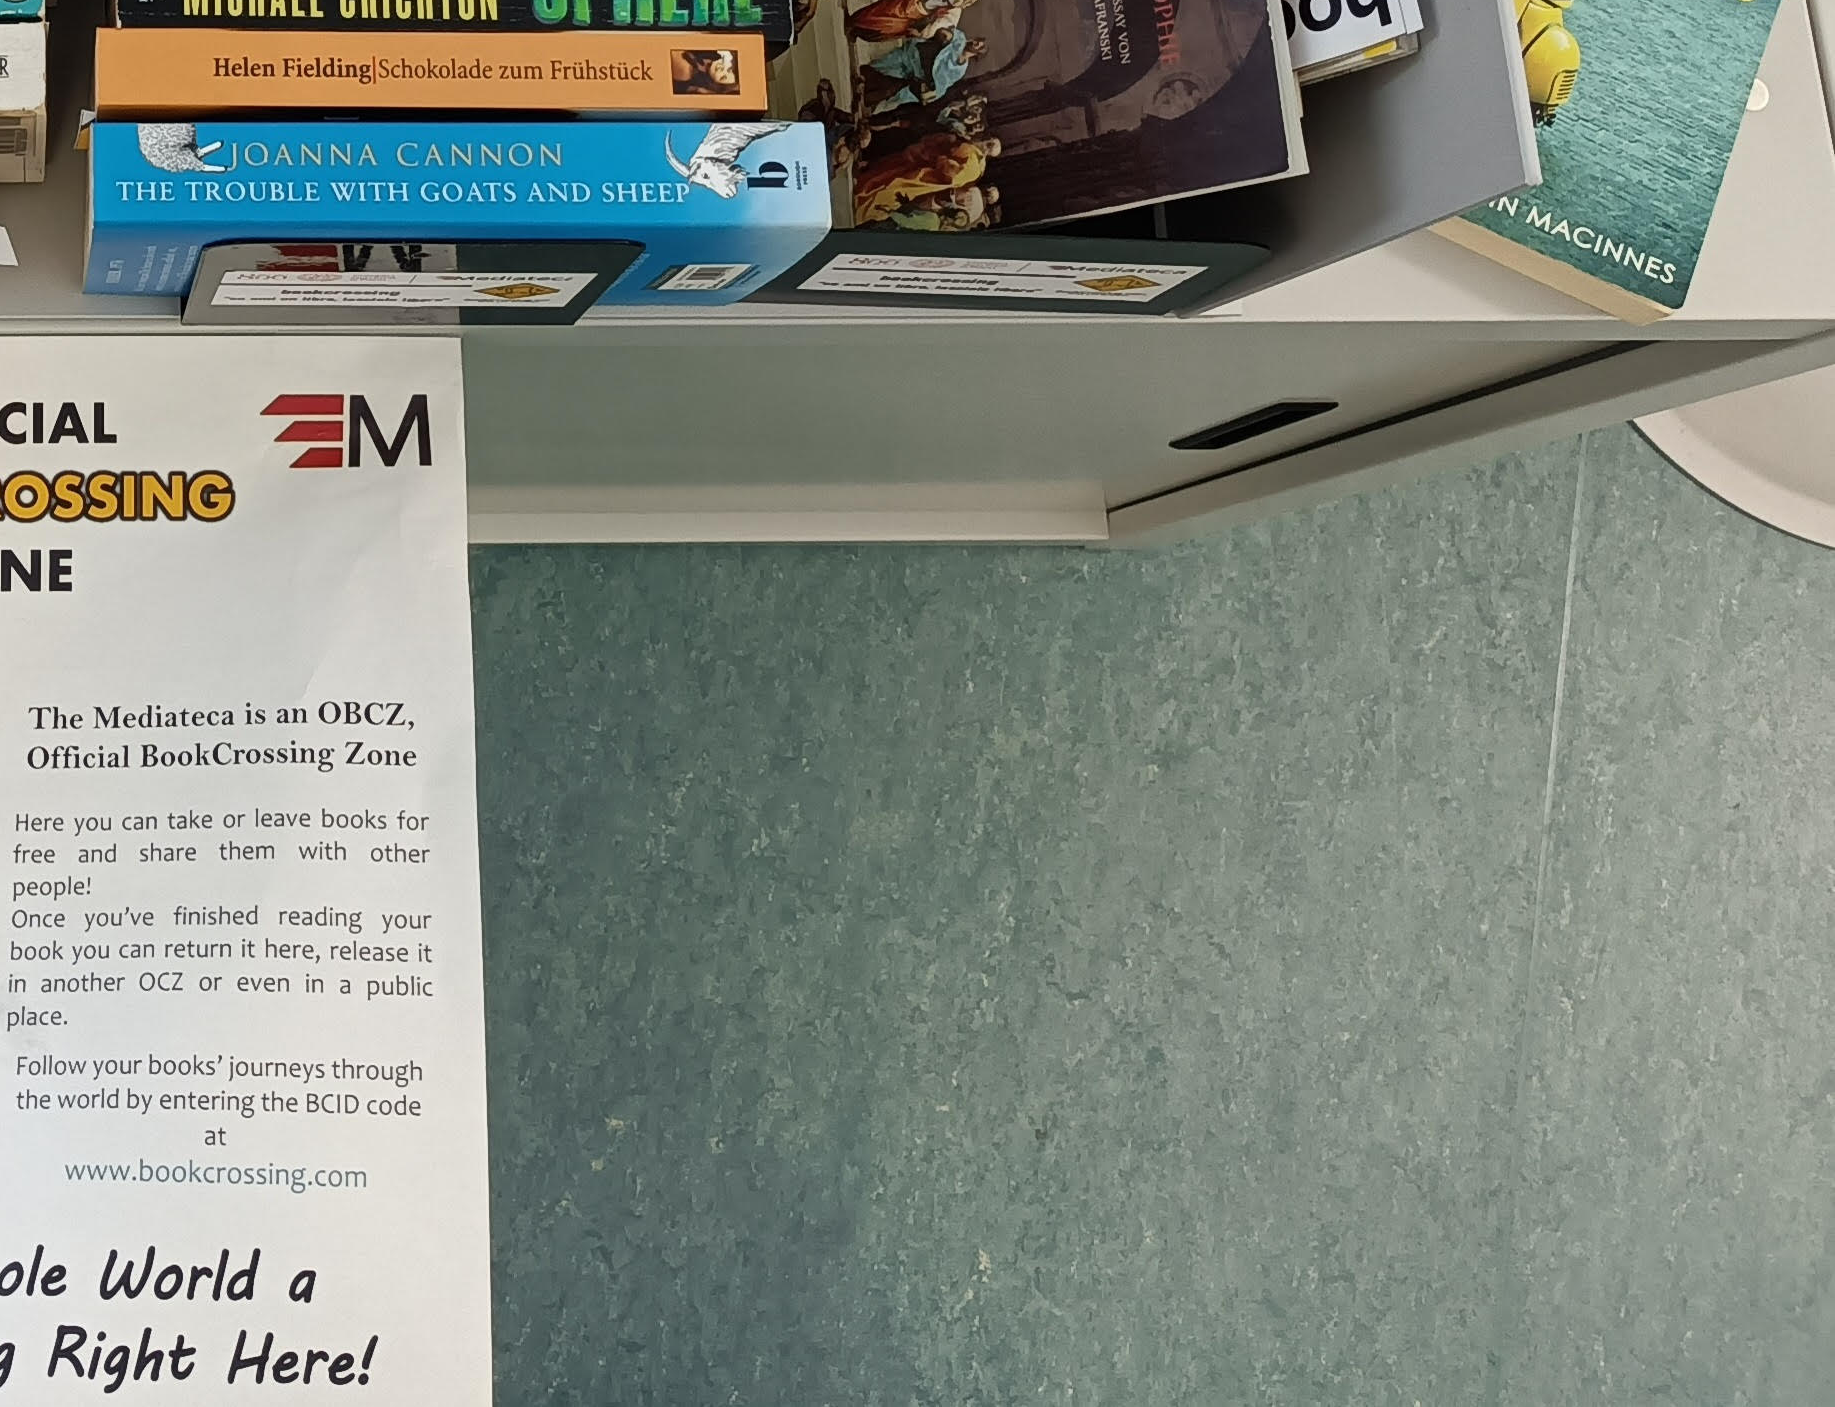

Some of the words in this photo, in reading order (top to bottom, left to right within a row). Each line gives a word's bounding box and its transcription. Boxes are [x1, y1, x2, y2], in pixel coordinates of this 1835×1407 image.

[1526, 205, 1677, 285] MACINNES
[14, 812, 65, 833] Here
[73, 816, 113, 837] you
[121, 815, 159, 832] can
[166, 809, 213, 831] take
[222, 813, 247, 830] or
[254, 808, 312, 829] leave
[321, 807, 388, 831] books
[396, 809, 430, 832] for
[64, 1157, 368, 1195] www.bookcrossing.com
[99, 1245, 262, 1302] World
[288, 1269, 317, 1304] a
